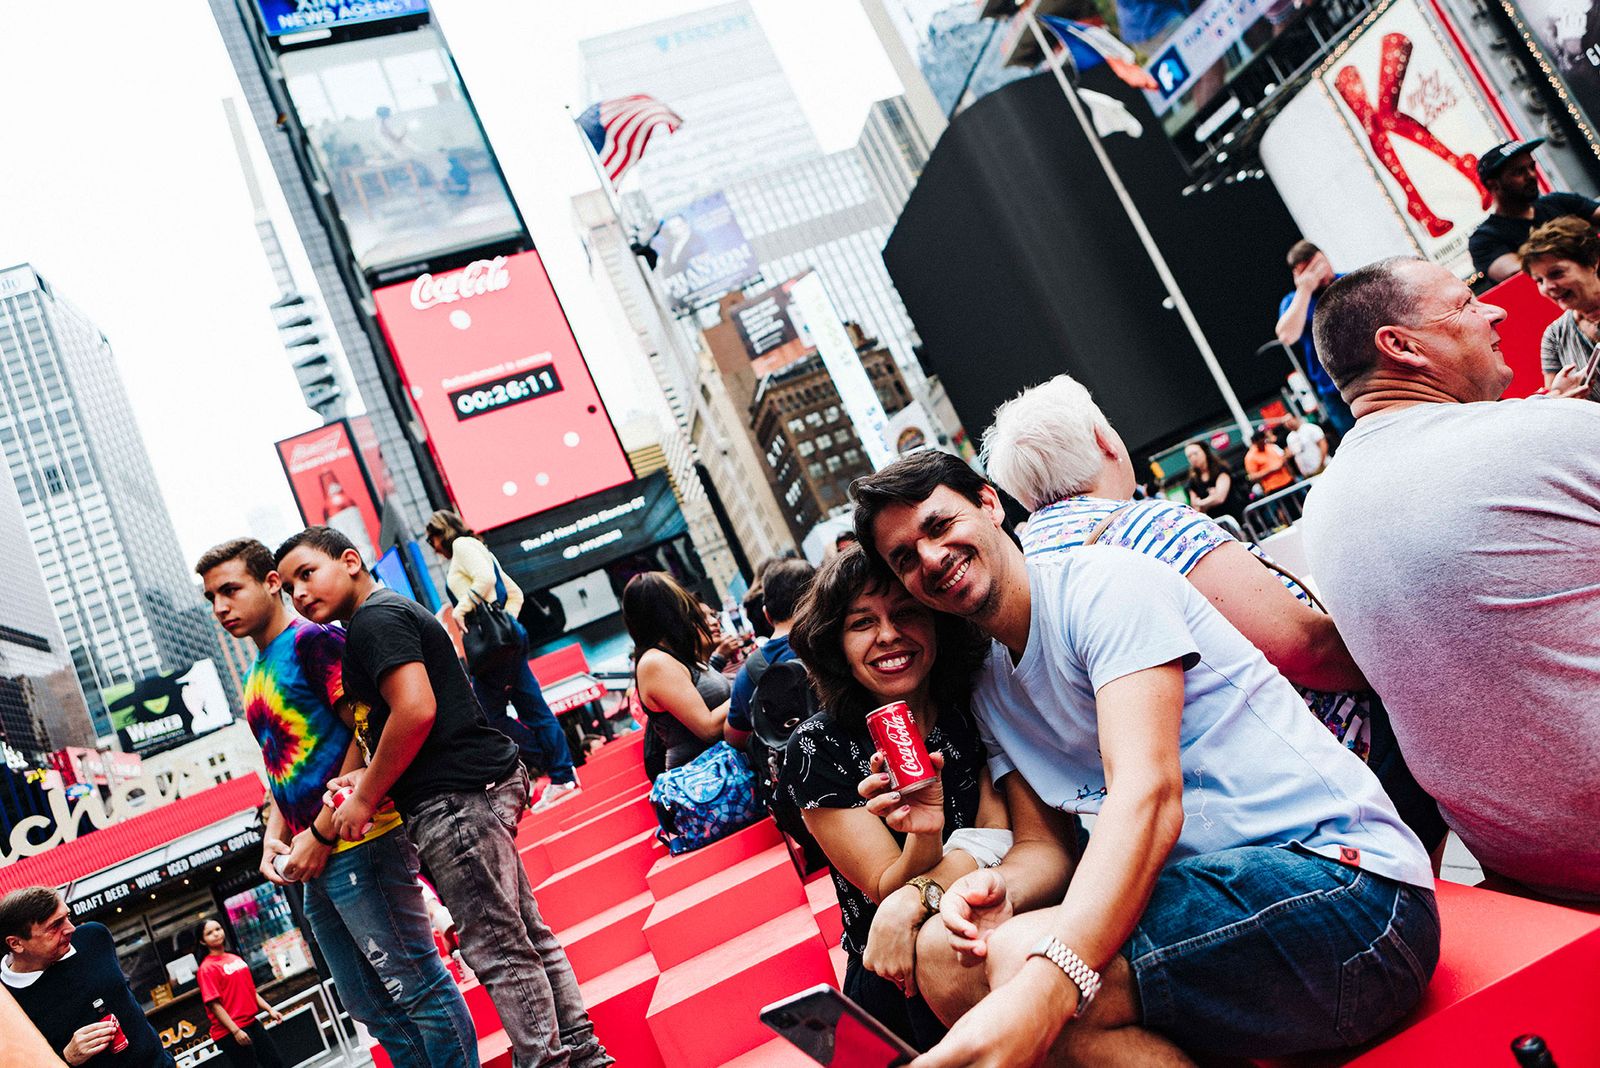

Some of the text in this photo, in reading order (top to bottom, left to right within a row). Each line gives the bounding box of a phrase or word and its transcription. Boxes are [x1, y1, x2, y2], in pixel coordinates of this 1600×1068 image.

[277, 9, 336, 28] NEWS
[457, 371, 554, 414] 00:26:11
[880, 714, 924, 777] Coca-Cola
[72, 893, 104, 916] DRAFT
[104, 883, 130, 904] BEER
[135, 871, 162, 890] WINE
[166, 858, 190, 877] ICED
[188, 844, 224, 868] DRINKS
[158, 1019, 198, 1049] as
